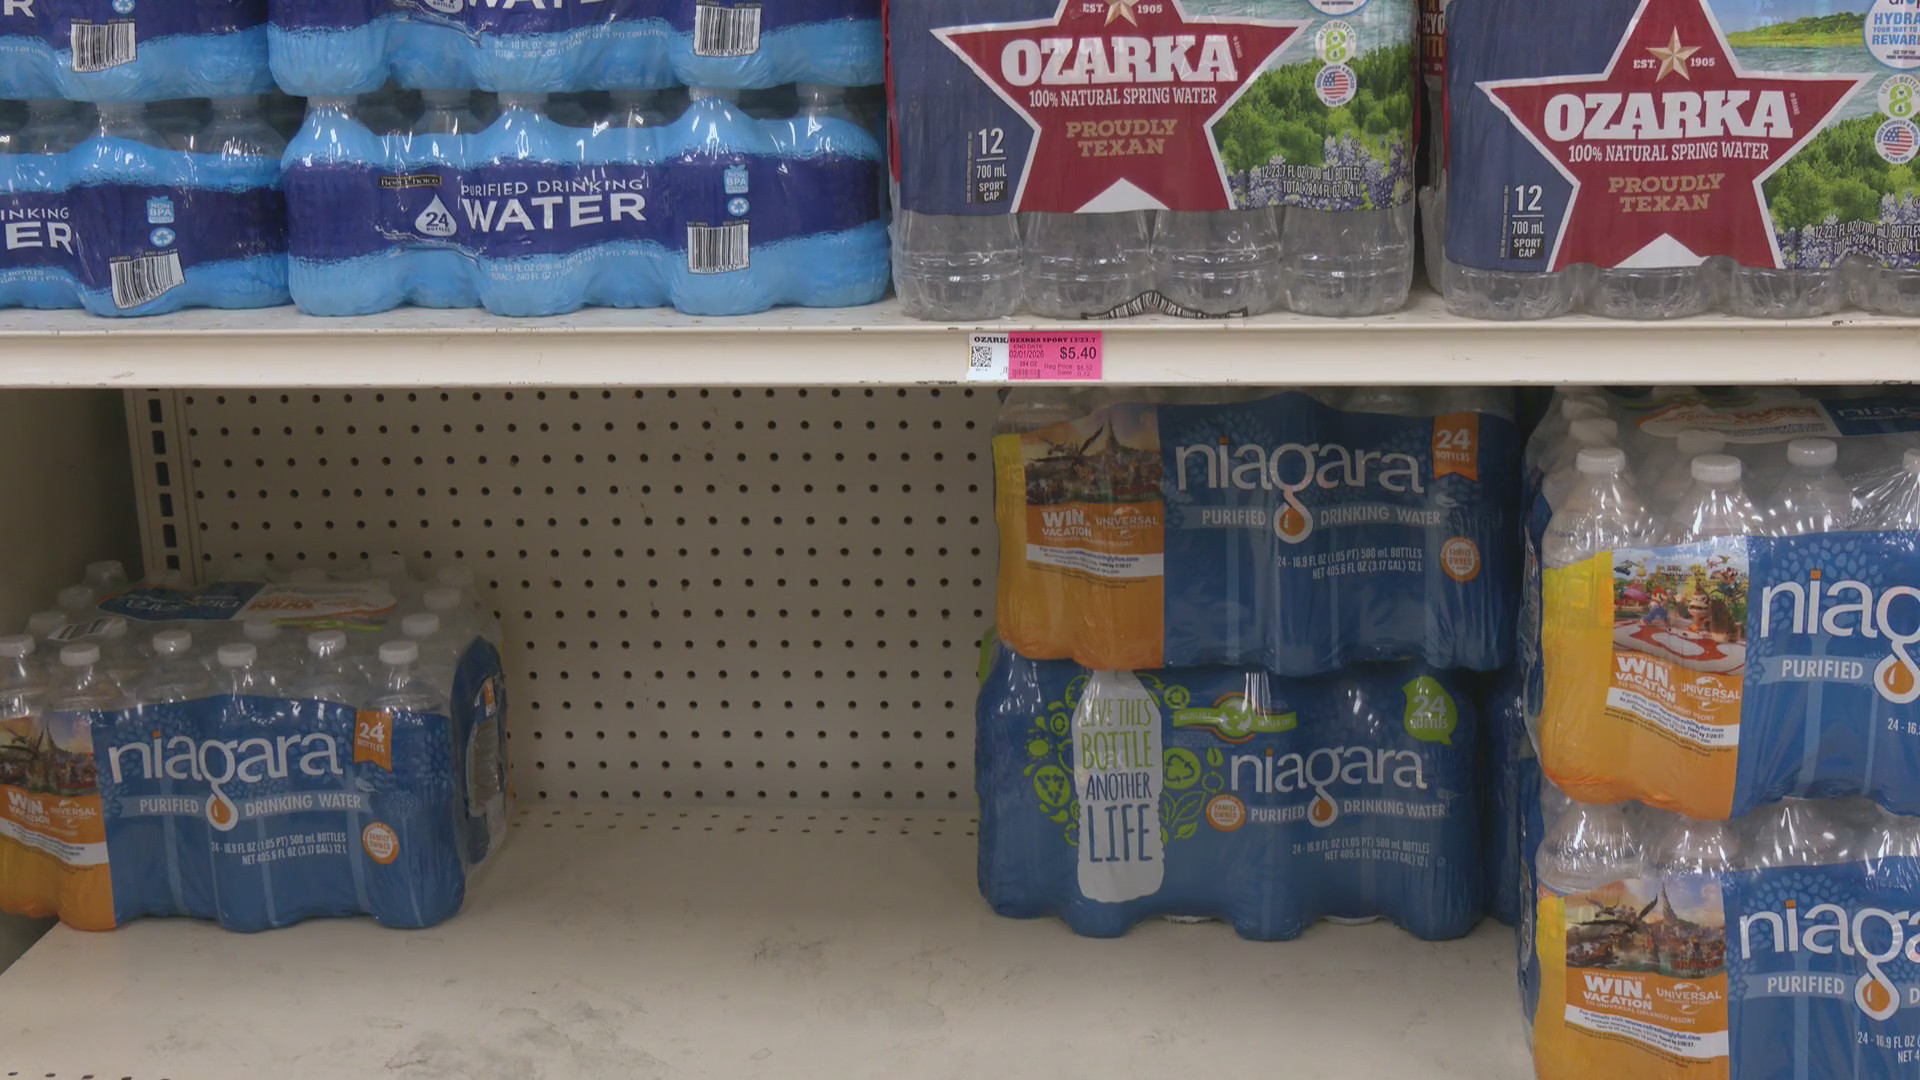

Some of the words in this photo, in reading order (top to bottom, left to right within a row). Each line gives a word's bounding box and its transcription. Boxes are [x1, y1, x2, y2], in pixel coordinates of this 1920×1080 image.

[1083, 3, 1104, 13] EST.
[1137, 4, 1162, 13] 1905
[1000, 35, 1238, 86] OZARKA
[1633, 60, 1657, 69] EST.
[1690, 57, 1715, 67] 1905
[1029, 90, 1059, 108] 100%
[1061, 88, 1121, 106] NATURAL
[1123, 87, 1170, 106] SPRING
[1172, 86, 1217, 105] WATER
[1544, 90, 1793, 142] OZARKA
[1065, 119, 1178, 138] PROUDLY
[978, 127, 1004, 155] 12
[1077, 139, 1165, 157] TEXAN
[1569, 145, 1602, 162] 100%
[1606, 144, 1668, 162] NATURAL
[1671, 143, 1718, 161] SPRING
[1721, 142, 1769, 160] WATER
[976, 165, 991, 179] 700
[994, 163, 1007, 177] mL
[1288, 165, 1295, 178] FL
[1297, 165, 1305, 178] OZ
[1336, 166, 1360, 181] BOTTLES
[461, 182, 528, 196] PURIFIED
[537, 179, 643, 194] DRINKING
[727, 178, 747, 186] BPA
[979, 181, 1004, 192] SPORT
[1324, 186, 1331, 197] FL
[1333, 185, 1341, 197] OZ
[1608, 173, 1725, 193] PROUDLY
[984, 191, 999, 202] CAP
[1515, 185, 1542, 211] 12
[1619, 194, 1710, 213] TEXAN
[0, 207, 69, 221] INKING
[150, 209, 173, 217] BPA
[426, 212, 449, 228] 24
[461, 193, 647, 232] WATER
[1512, 221, 1528, 234] 700
[1531, 221, 1544, 234] mL
[1839, 224, 1845, 238] FL
[1847, 221, 1856, 233] OZ
[1858, 220, 1875, 235] (700
[5, 221, 73, 255] ER
[1514, 238, 1542, 248] SPORT
[1878, 240, 1886, 254] FL
[1888, 240, 1897, 254] OZ
[1519, 248, 1536, 257] CAP
[974, 336, 1008, 344] OZARK
[1009, 350, 1044, 358] 02/01/2026
[1060, 346, 1097, 360] $5.40
[1436, 429, 1471, 449] 24
[1436, 450, 1470, 462] BOTTLES
[1176, 436, 1424, 544] niagara
[1042, 508, 1084, 527] WIN
[1096, 516, 1159, 526] UNIVERSAL
[1202, 510, 1266, 525] PURIFIED
[1321, 507, 1389, 525] DRINKING
[1397, 507, 1440, 525] WATER
[1042, 526, 1091, 538] VACATION
[1277, 556, 1286, 567] 24
[1309, 556, 1317, 566] FL
[1361, 548, 1375, 559] 500
[1377, 548, 1388, 558] mL
[1390, 547, 1422, 559] BOTTLES
[1313, 568, 1325, 580] NET
[1347, 563, 1356, 573] FL
[1388, 560, 1406, 572] GAL)
[1760, 568, 1920, 704] niag
[1617, 656, 1668, 689] WIN
[1782, 659, 1863, 680] PURIFIED
[1615, 672, 1675, 703] VACATION
[1681, 683, 1741, 699] UNIVERSAL
[1117, 698, 1152, 726] THIS
[1412, 695, 1447, 717] 24
[359, 722, 385, 742] 24
[1410, 719, 1448, 729] BOTTLES
[1888, 717, 1898, 731] 24
[357, 738, 384, 752] BOTTLES
[1081, 731, 1154, 772] BOTTLE
[108, 730, 343, 831] niagara
[1085, 772, 1152, 800] ANOTHER
[1231, 746, 1427, 828] niagara
[8, 791, 43, 814] WIN
[140, 799, 198, 812] PURIFIED
[245, 795, 312, 817] DRINKING
[319, 793, 361, 809] WATER
[1252, 806, 1305, 821] PURIFIED
[1344, 800, 1404, 817] DRINKING
[1406, 803, 1445, 817] WATER
[1087, 804, 1152, 862] LIFE
[1583, 975, 1642, 998] WIN
[1656, 987, 1722, 1000] UNIVERSAL
[1767, 976, 1845, 996] PURIFIED
[1583, 991, 1652, 1010] VACATION
[1596, 1002, 1635, 1013] UNIVERSAL
[1636, 1009, 1669, 1020] ORLANDO
[1671, 1016, 1696, 1024] RESORT
[1857, 1032, 1868, 1044] 24
[1876, 1035, 1891, 1048] 16.9
[1894, 1036, 1902, 1048] FL
[1904, 1035, 1915, 1047] OZ
[1898, 1051, 1912, 1063] NET
